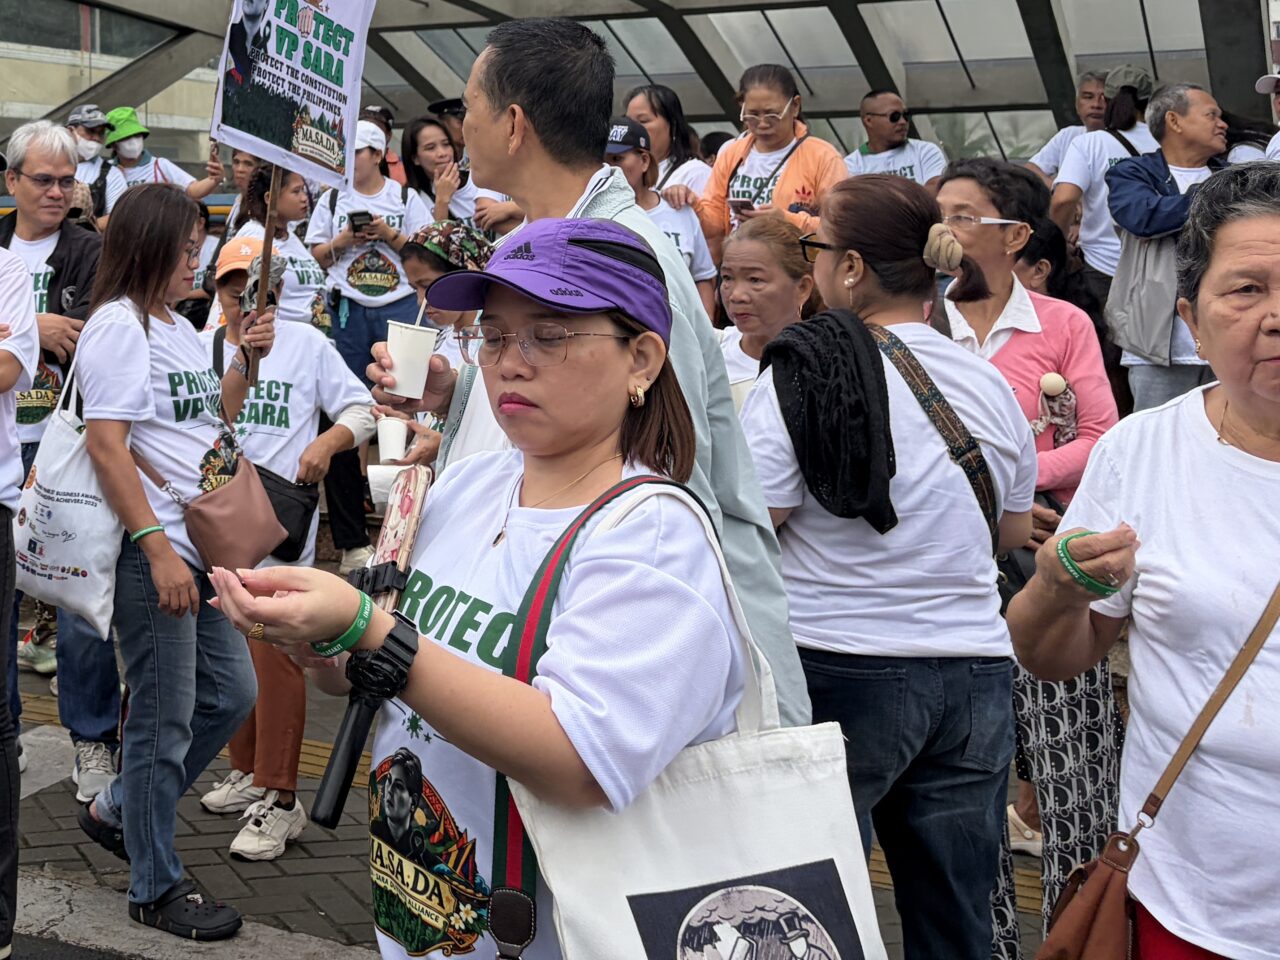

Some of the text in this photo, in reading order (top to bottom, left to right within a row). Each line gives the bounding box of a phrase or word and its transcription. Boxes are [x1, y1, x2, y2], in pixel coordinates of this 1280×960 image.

[249, 48, 348, 106] PROTECT THE CONSTITUTION
[276, 24, 343, 88] VP SARA
[252, 63, 341, 117] PROTECT THE PHILIPPINES
[504, 252, 535, 261] adidas
[549, 287, 583, 297] adidas
[172, 396, 205, 423] VP
[398, 569, 517, 669] ROTEC
[370, 838, 445, 910] A.SA.DA
[408, 899, 440, 922] ALLIANCE
